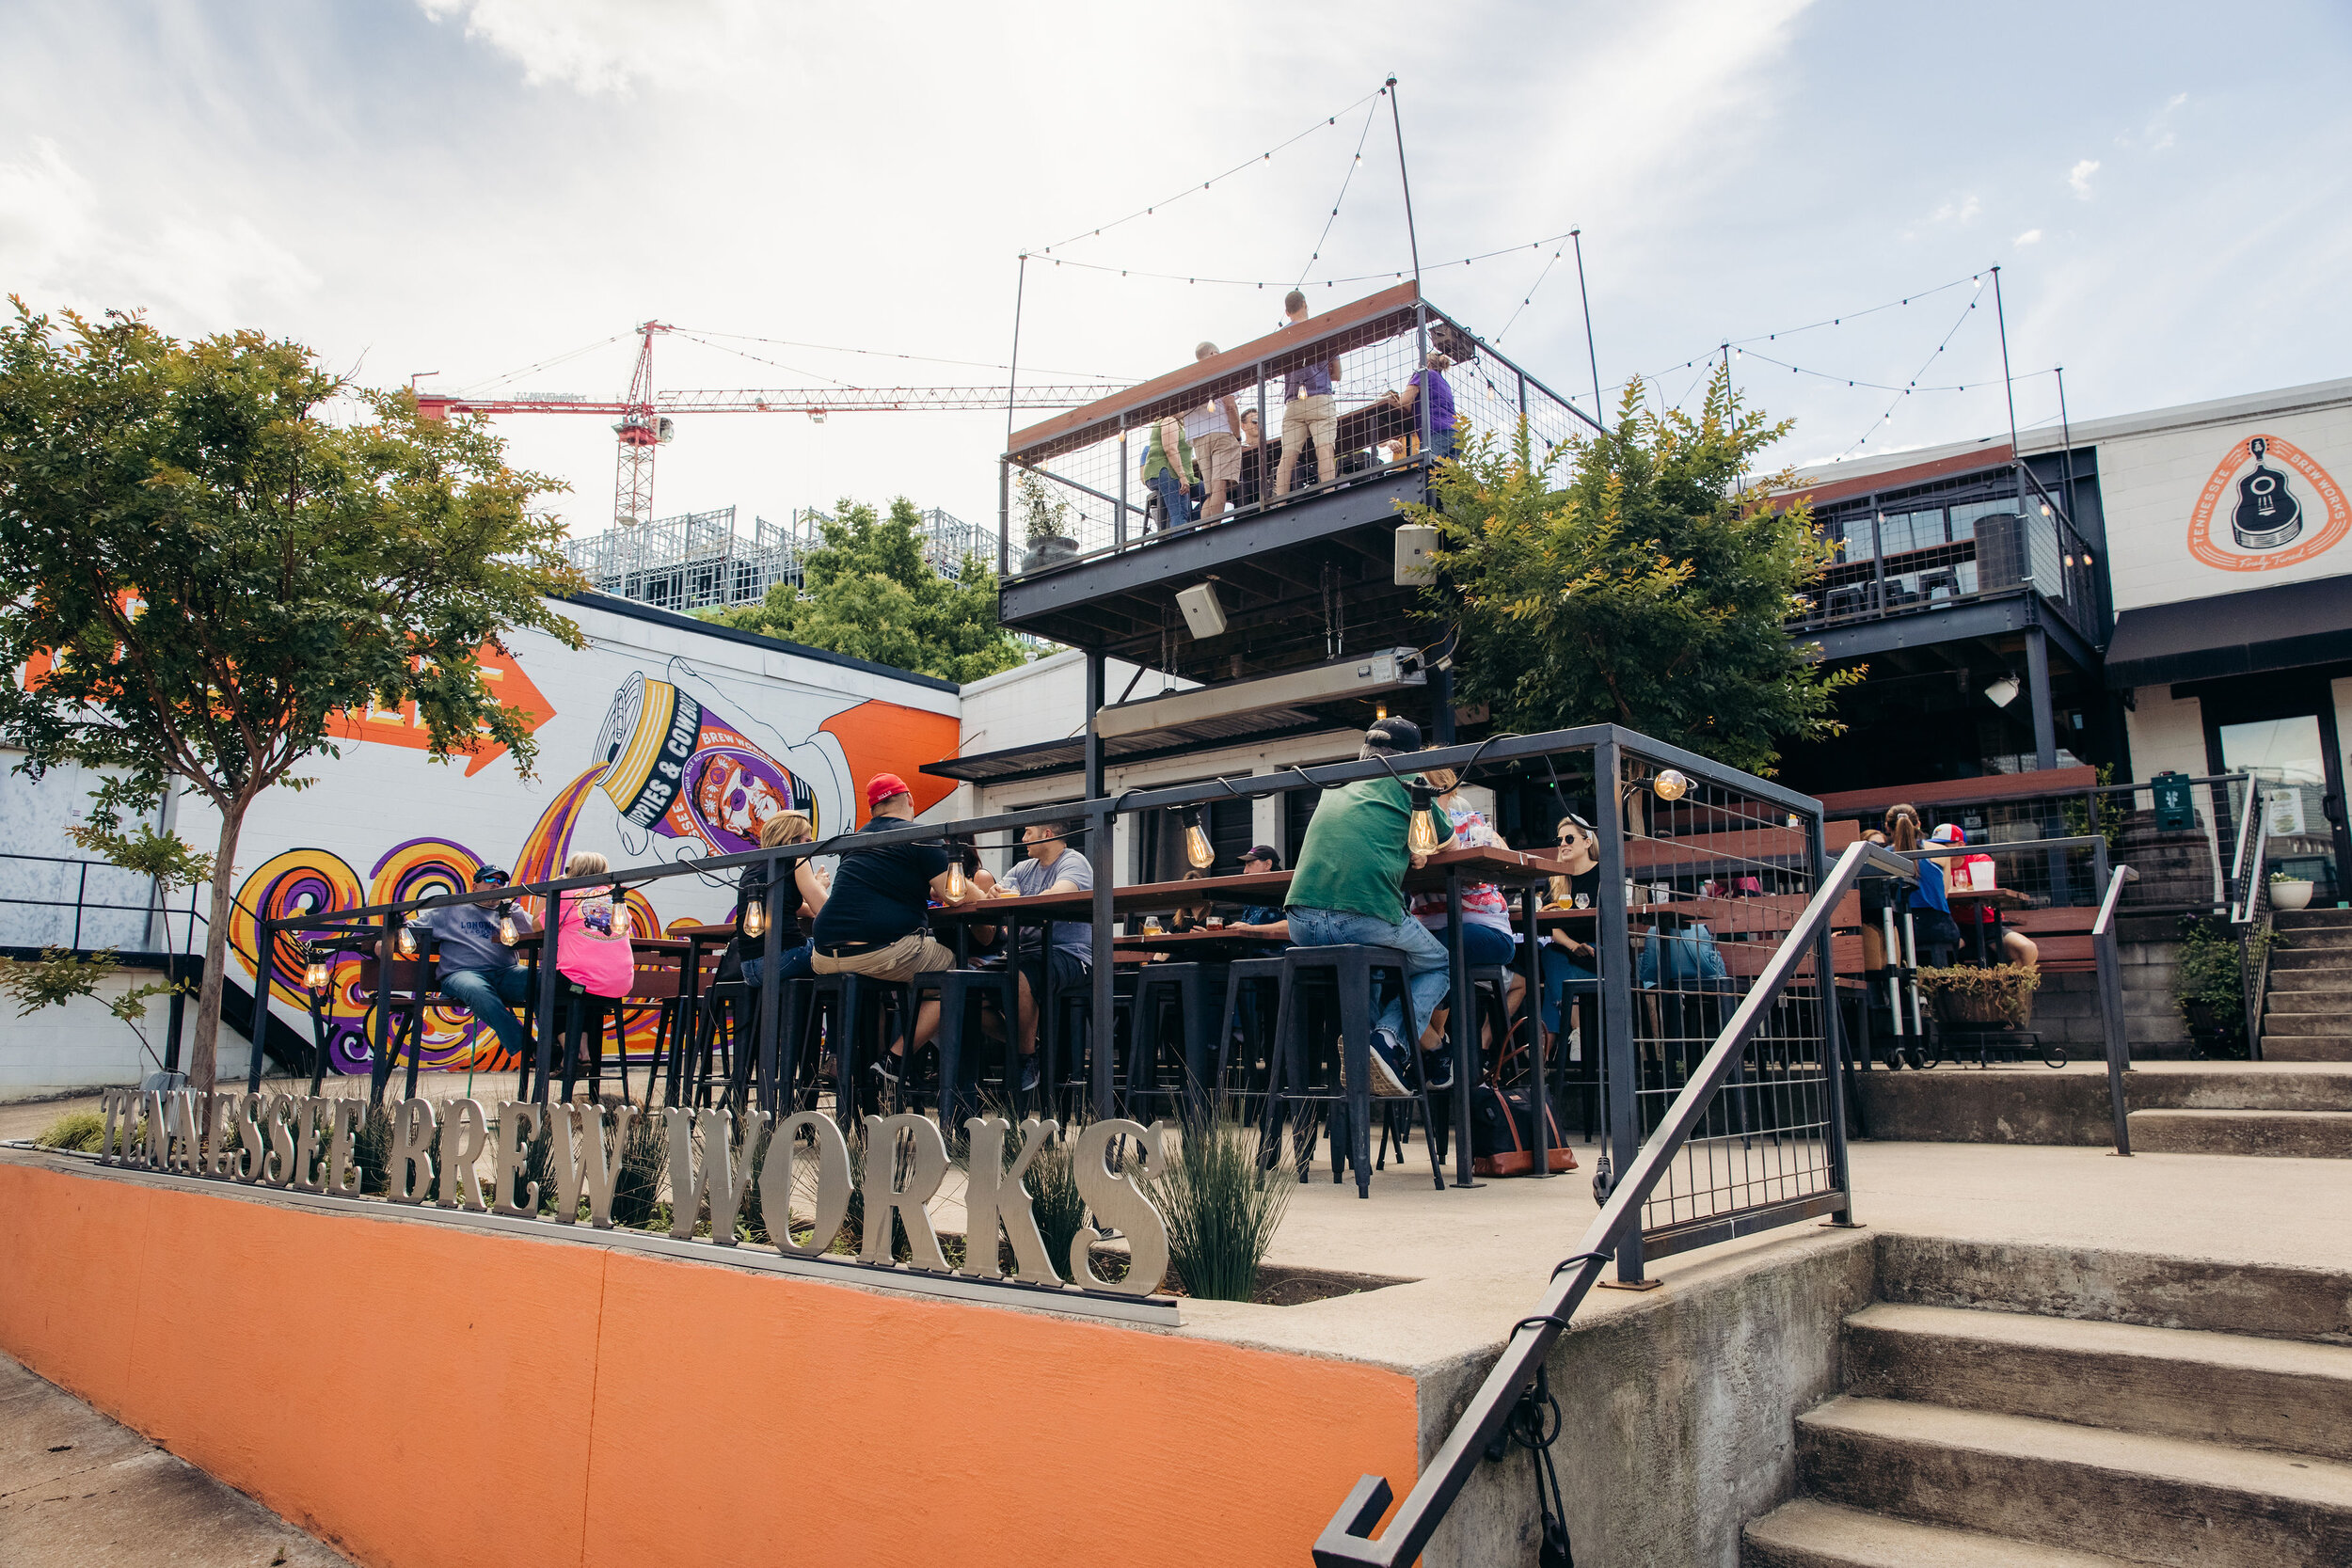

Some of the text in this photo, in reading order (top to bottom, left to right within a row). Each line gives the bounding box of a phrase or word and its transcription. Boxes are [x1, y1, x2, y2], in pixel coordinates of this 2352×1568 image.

[2290, 453, 2345, 520] BREW WORKS
[2193, 468, 2231, 545] TENNESSEE
[2238, 547, 2305, 571] Finely Tuned
[701, 732, 734, 745] BREW
[659, 760, 682, 780] &
[686, 761, 695, 774] PALE
[693, 753, 703, 763] ALE
[101, 1087, 1169, 1298] TENNESSEE BREW WORKS
